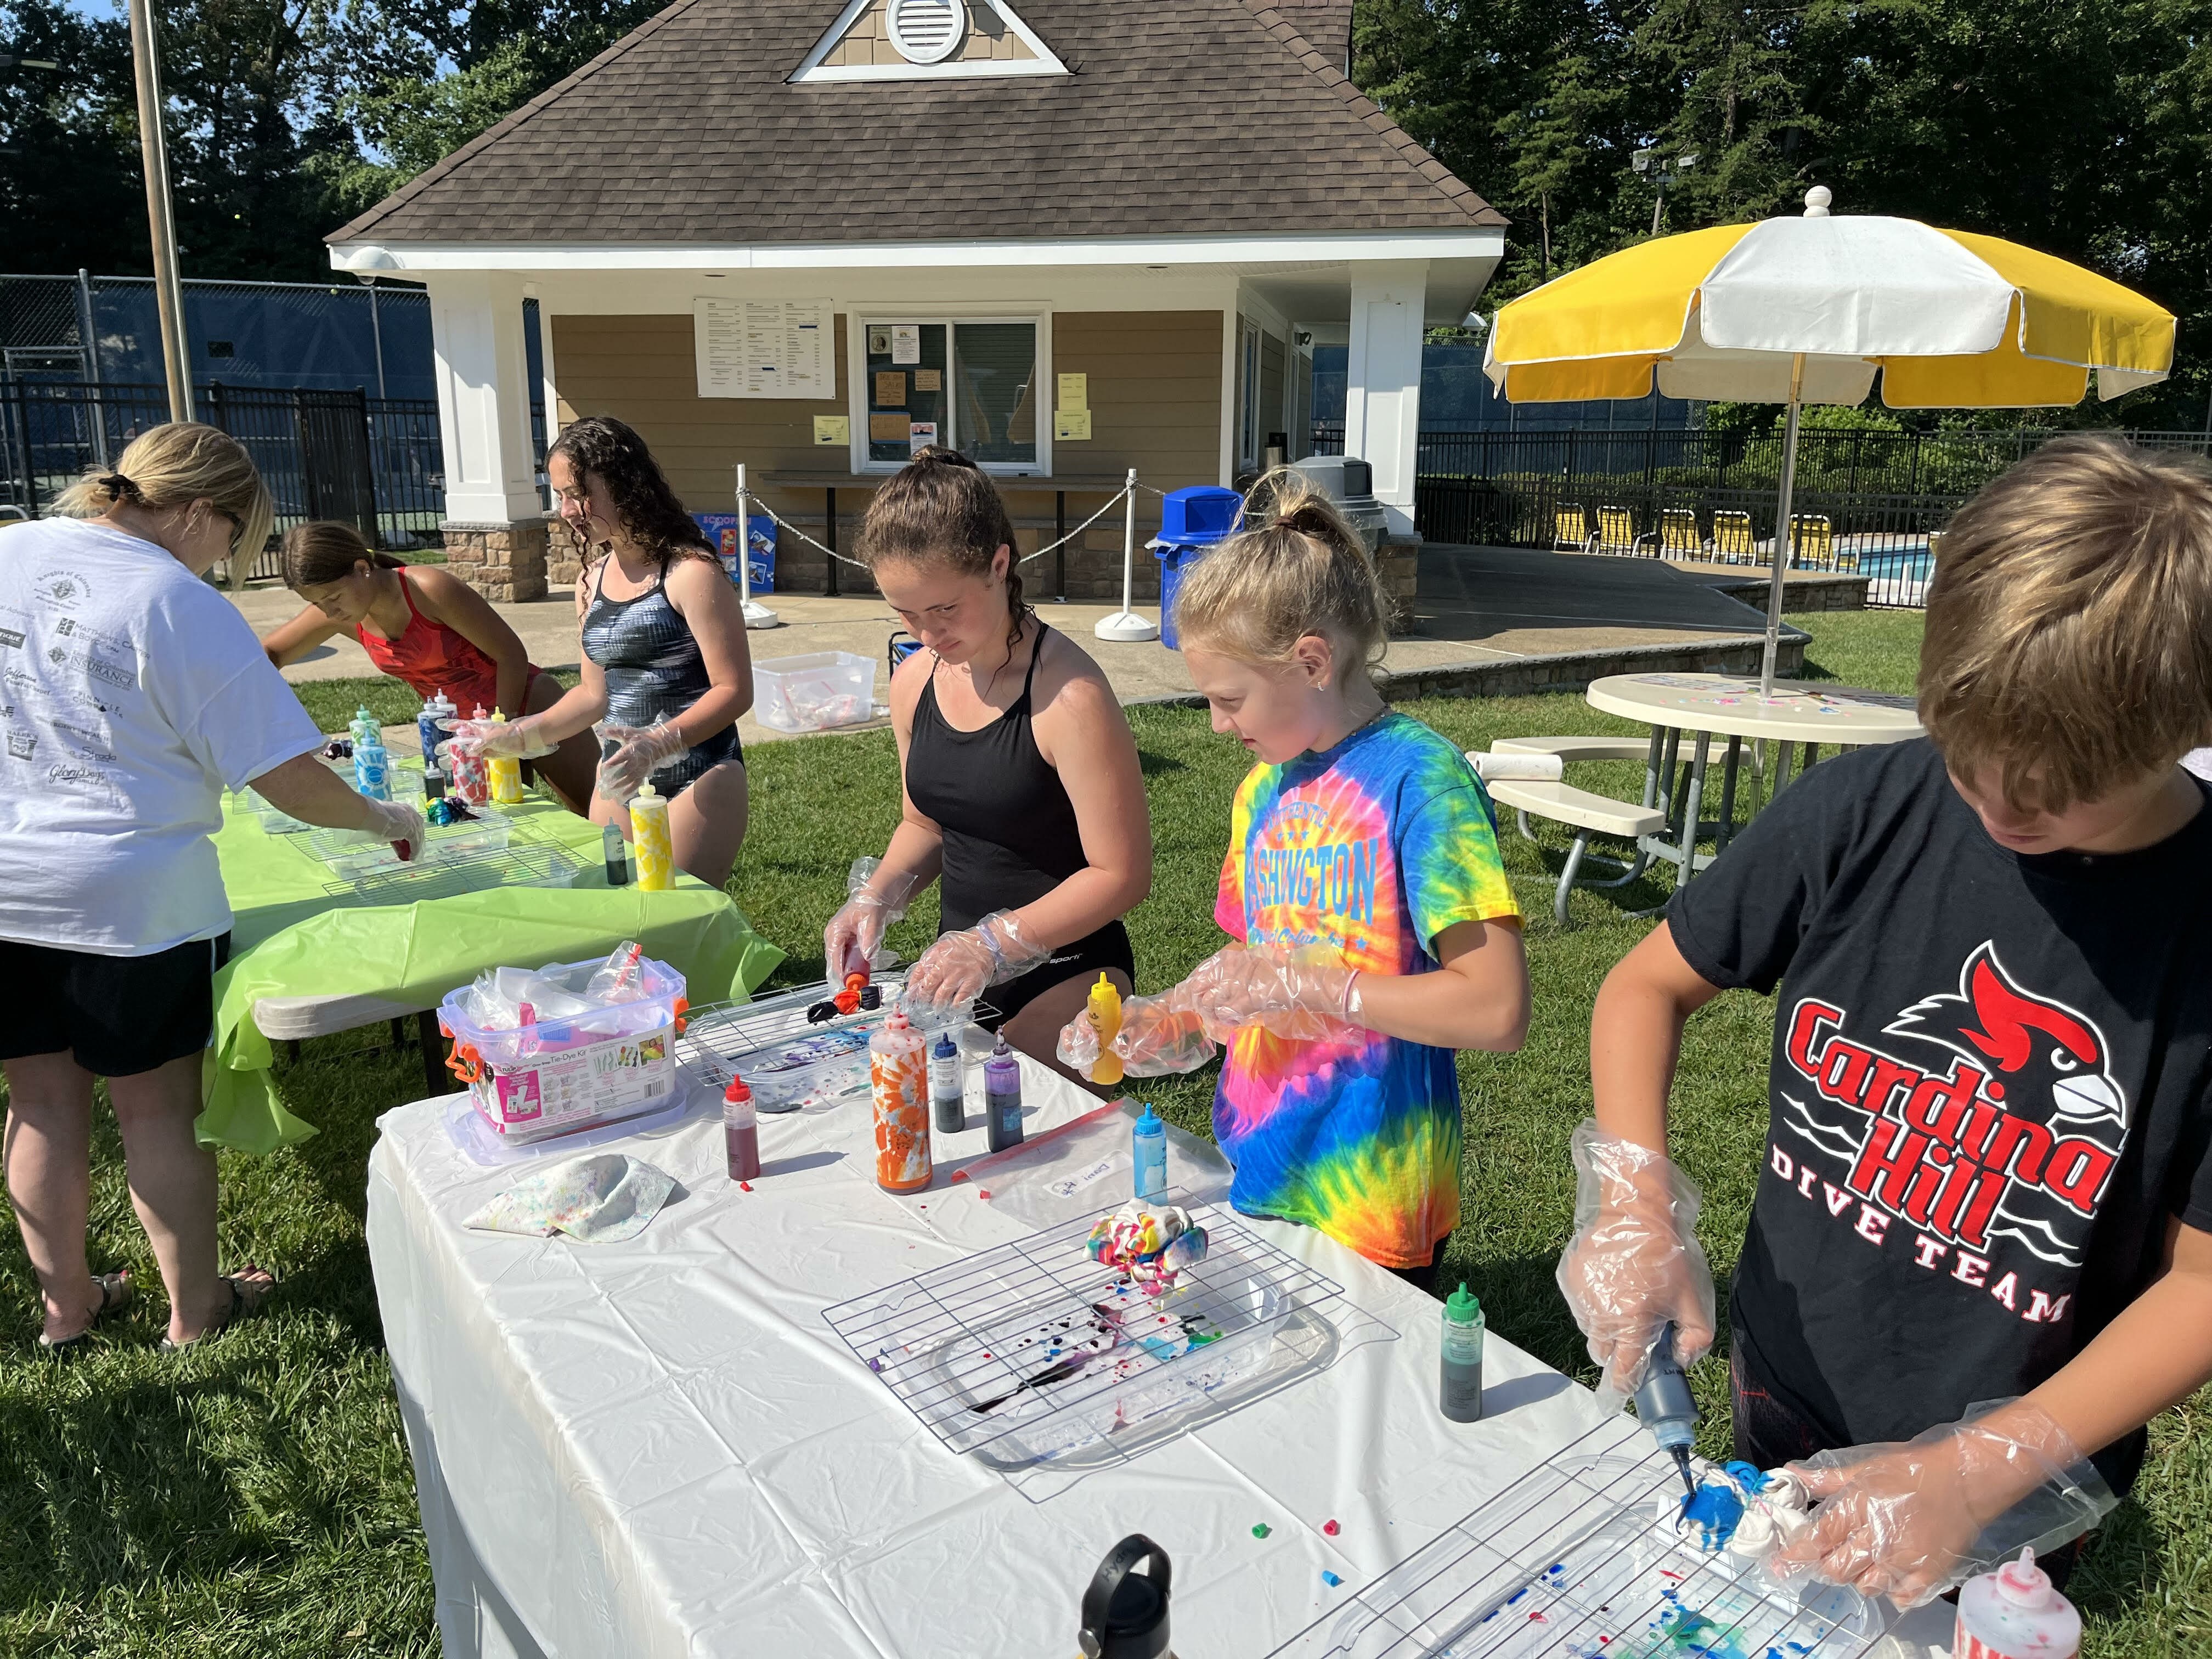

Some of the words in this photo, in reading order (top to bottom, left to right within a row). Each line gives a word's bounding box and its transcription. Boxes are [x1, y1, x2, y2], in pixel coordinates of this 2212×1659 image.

[70, 657, 134, 686] INSURANCE
[1785, 998, 2120, 1218] Cardina
[1846, 1115, 2011, 1253] Hill
[1770, 1143, 1892, 1245] DIVE
[1914, 1233, 2072, 1324] TEAM
